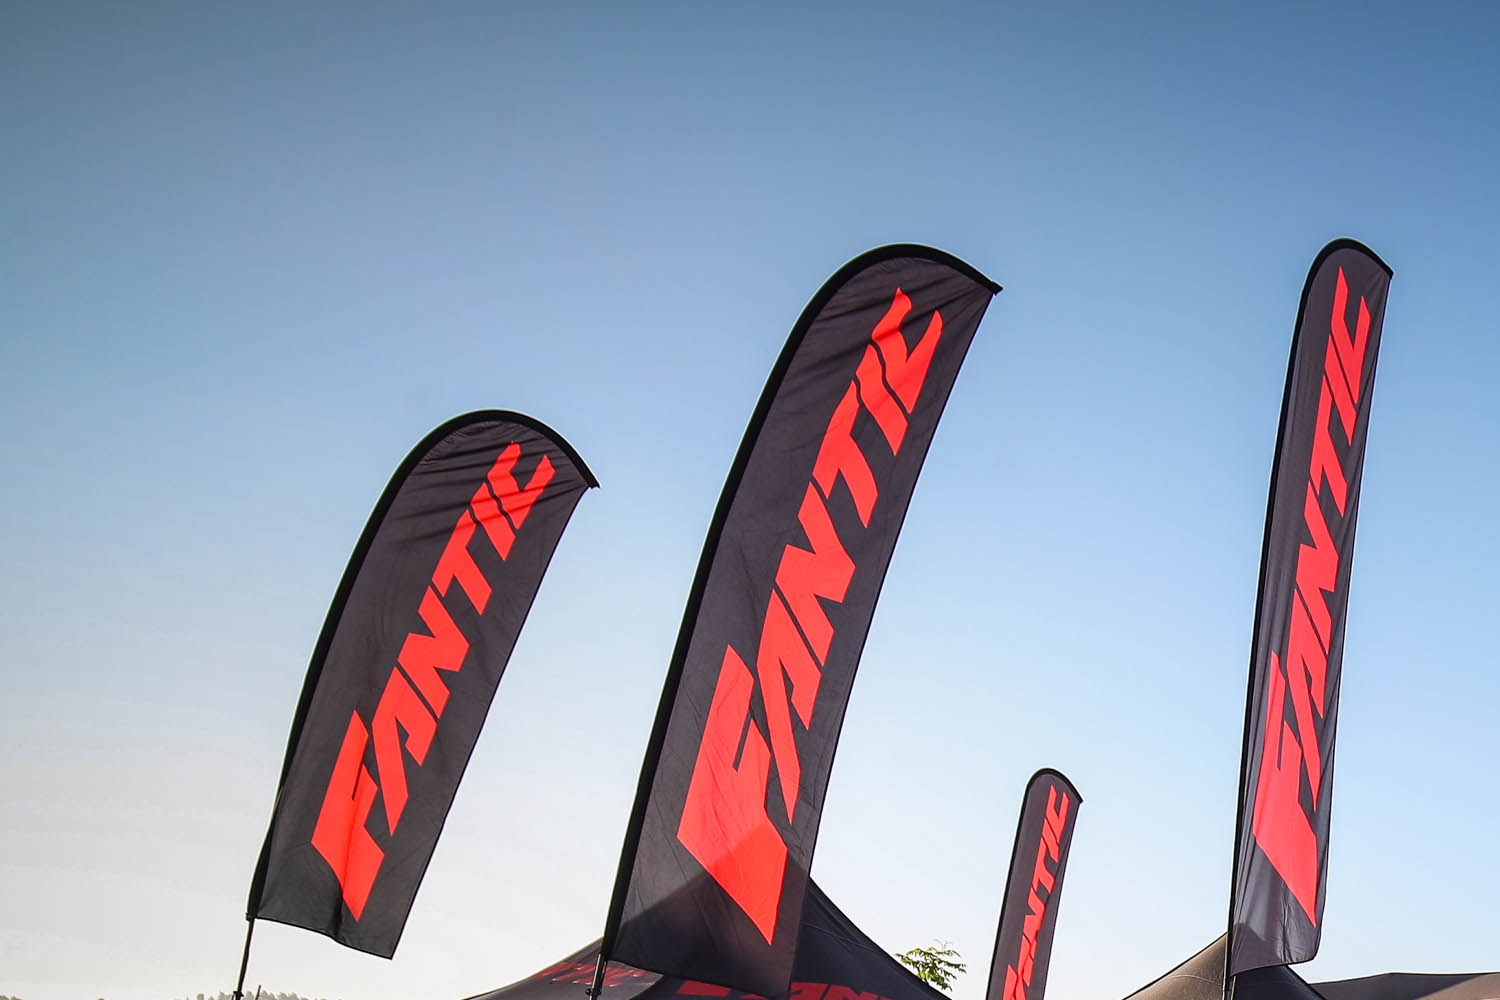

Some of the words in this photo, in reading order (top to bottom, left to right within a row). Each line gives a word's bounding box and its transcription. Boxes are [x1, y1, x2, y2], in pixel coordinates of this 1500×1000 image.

[311, 440, 556, 922] FANTIC
[676, 286, 943, 946] FANTIC
[1253, 265, 1372, 928] FANTIC
